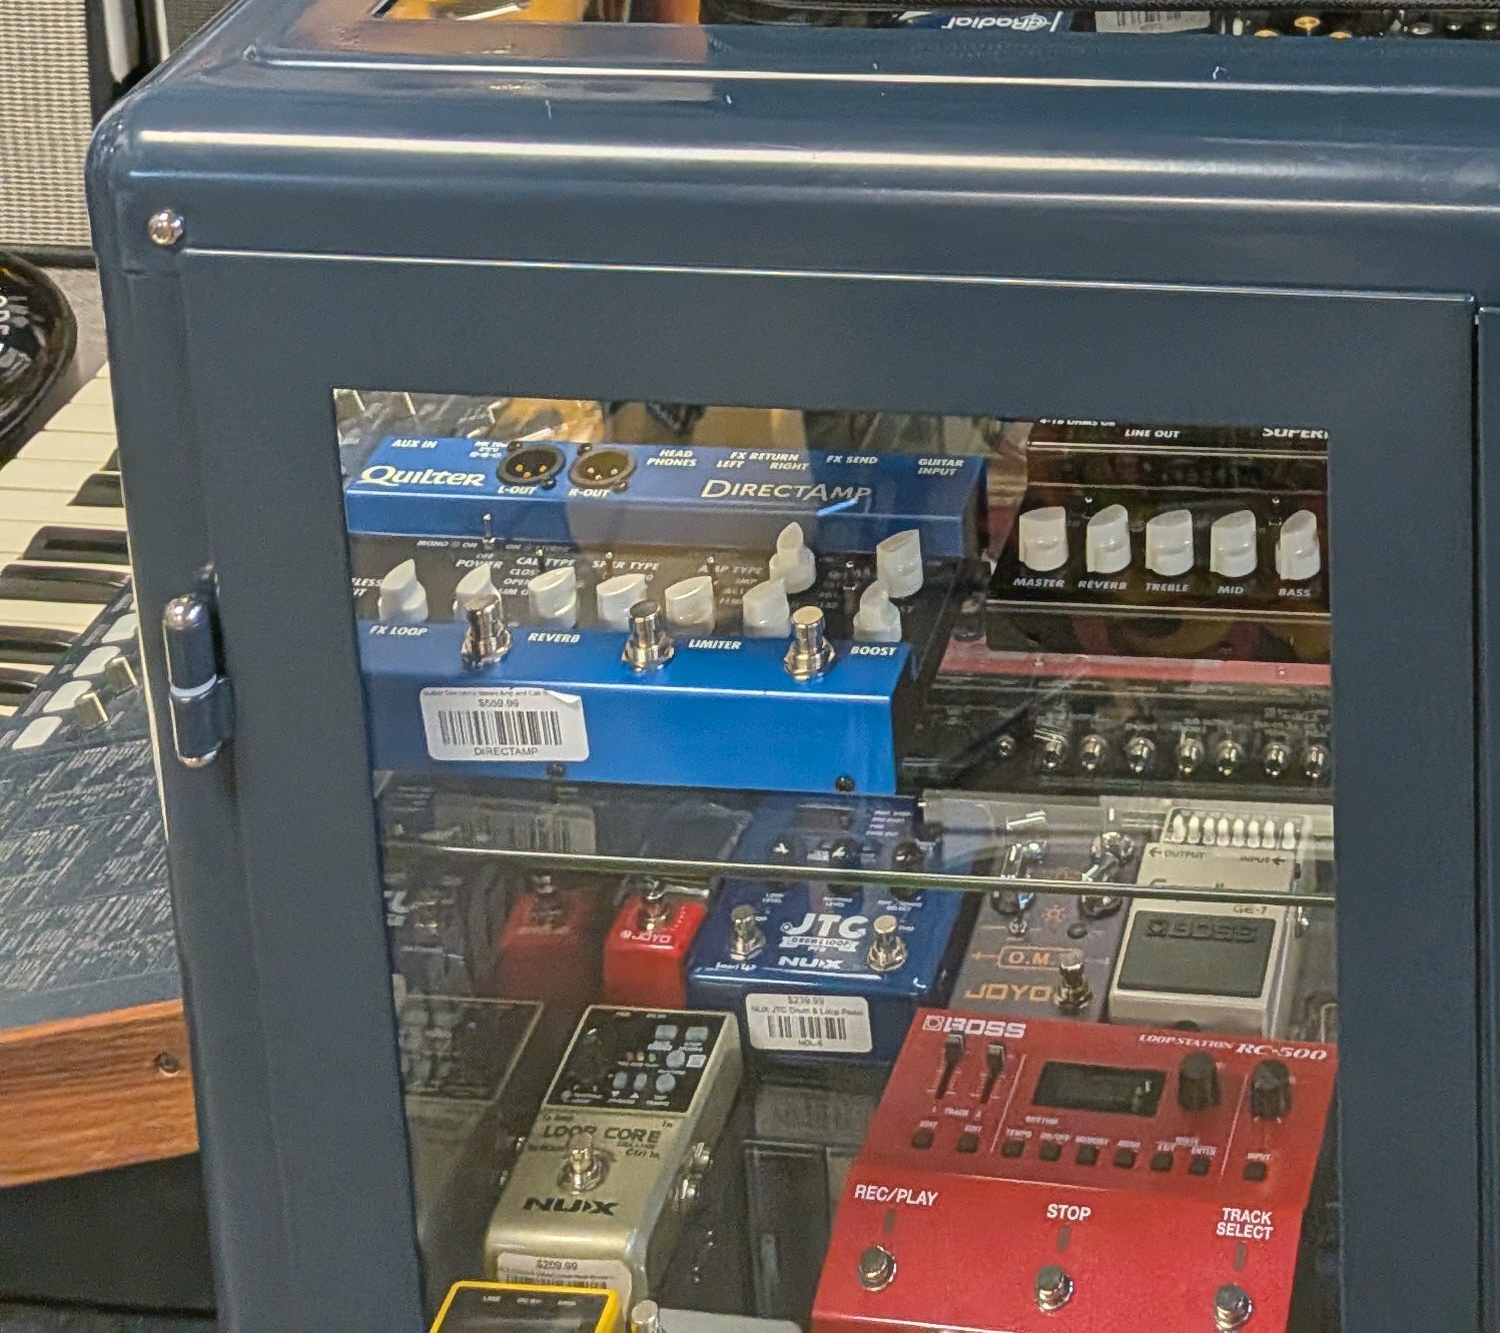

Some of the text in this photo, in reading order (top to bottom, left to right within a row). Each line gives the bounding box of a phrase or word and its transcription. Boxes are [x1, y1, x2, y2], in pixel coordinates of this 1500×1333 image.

[1124, 428, 1181, 439] LINE OUT
[659, 449, 693, 459] HEAD
[749, 452, 799, 462] RETURN
[646, 458, 698, 468] PHONES
[716, 460, 810, 471] LEFT RIGHT
[846, 456, 879, 465] SEND
[917, 458, 965, 467] GUITAR
[917, 467, 958, 476] INPUT
[1013, 577, 1065, 589] MASTER
[1078, 579, 1128, 591] REVERB
[1145, 581, 1190, 593] TREBLE
[1217, 585, 1245, 596] MID
[1278, 588, 1312, 598] BASS
[389, 625, 428, 636] LOOP
[528, 632, 582, 643] REVERB
[688, 638, 742, 650] LIMITER
[850, 645, 898, 657] BOOST
[474, 746, 539, 757] DIRECTAMP
[1164, 850, 1206, 860] OUTPUT
[780, 912, 869, 939] JTC
[963, 983, 1052, 1001] JOYO
[942, 1016, 1027, 1038] BOSS
[1139, 1033, 1328, 1061] LOOP STATION RC-500
[602, 1127, 662, 1143] CORE
[854, 1184, 939, 1206] REC/PLAY
[1046, 1202, 1091, 1221] STOP
[1221, 1206, 1272, 1226] TRACK
[1215, 1222, 1274, 1240] SELECT
